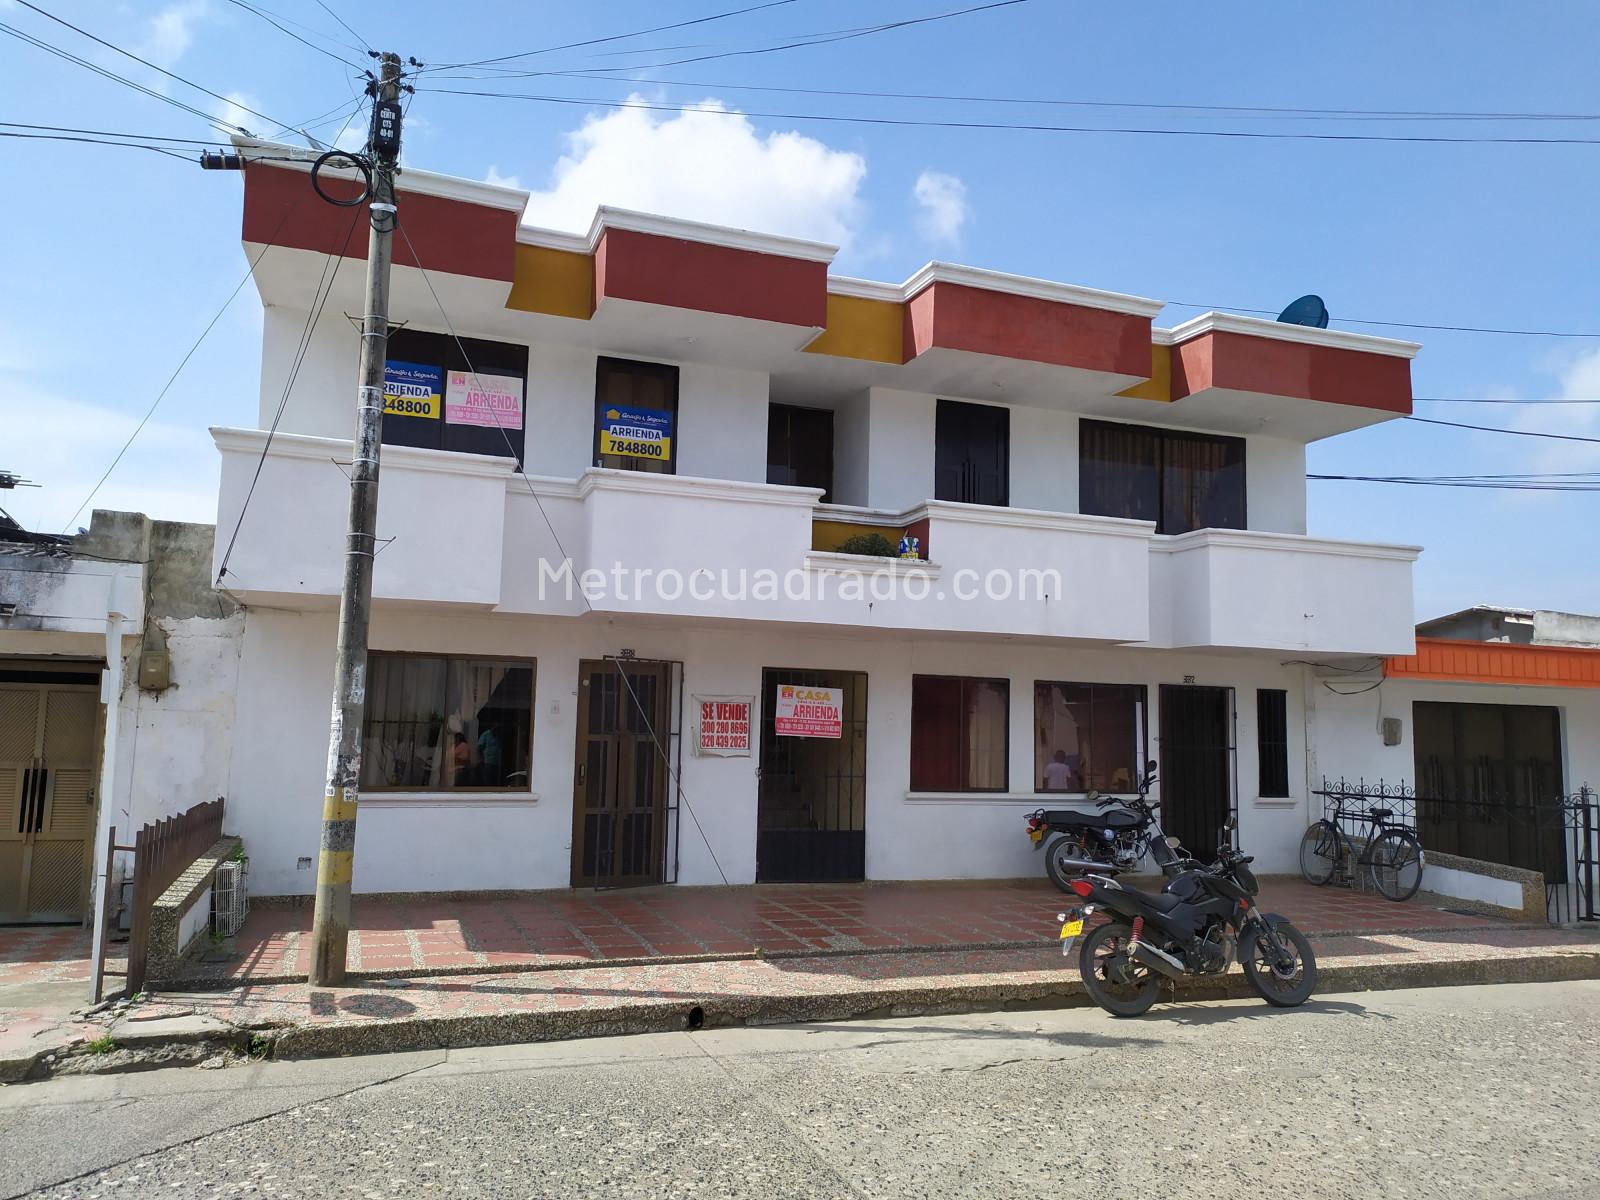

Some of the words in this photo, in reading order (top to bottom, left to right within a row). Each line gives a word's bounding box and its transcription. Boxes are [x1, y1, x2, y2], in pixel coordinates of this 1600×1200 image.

[384, 382, 430, 398] RRIENDA
[383, 398, 431, 414] 848800
[466, 391, 519, 410] ARRIENDA
[611, 426, 661, 440] ARRIENDA
[609, 440, 662, 457] 7848800
[796, 690, 831, 701] CASA
[702, 702, 714, 720] SE
[716, 703, 748, 721] VENDE
[793, 703, 839, 720] ARRIENDA
[701, 721, 715, 734] 300
[716, 721, 730, 734] 280
[701, 734, 715, 747] 320
[715, 735, 729, 748] 439
[730, 735, 747, 748] 2025
